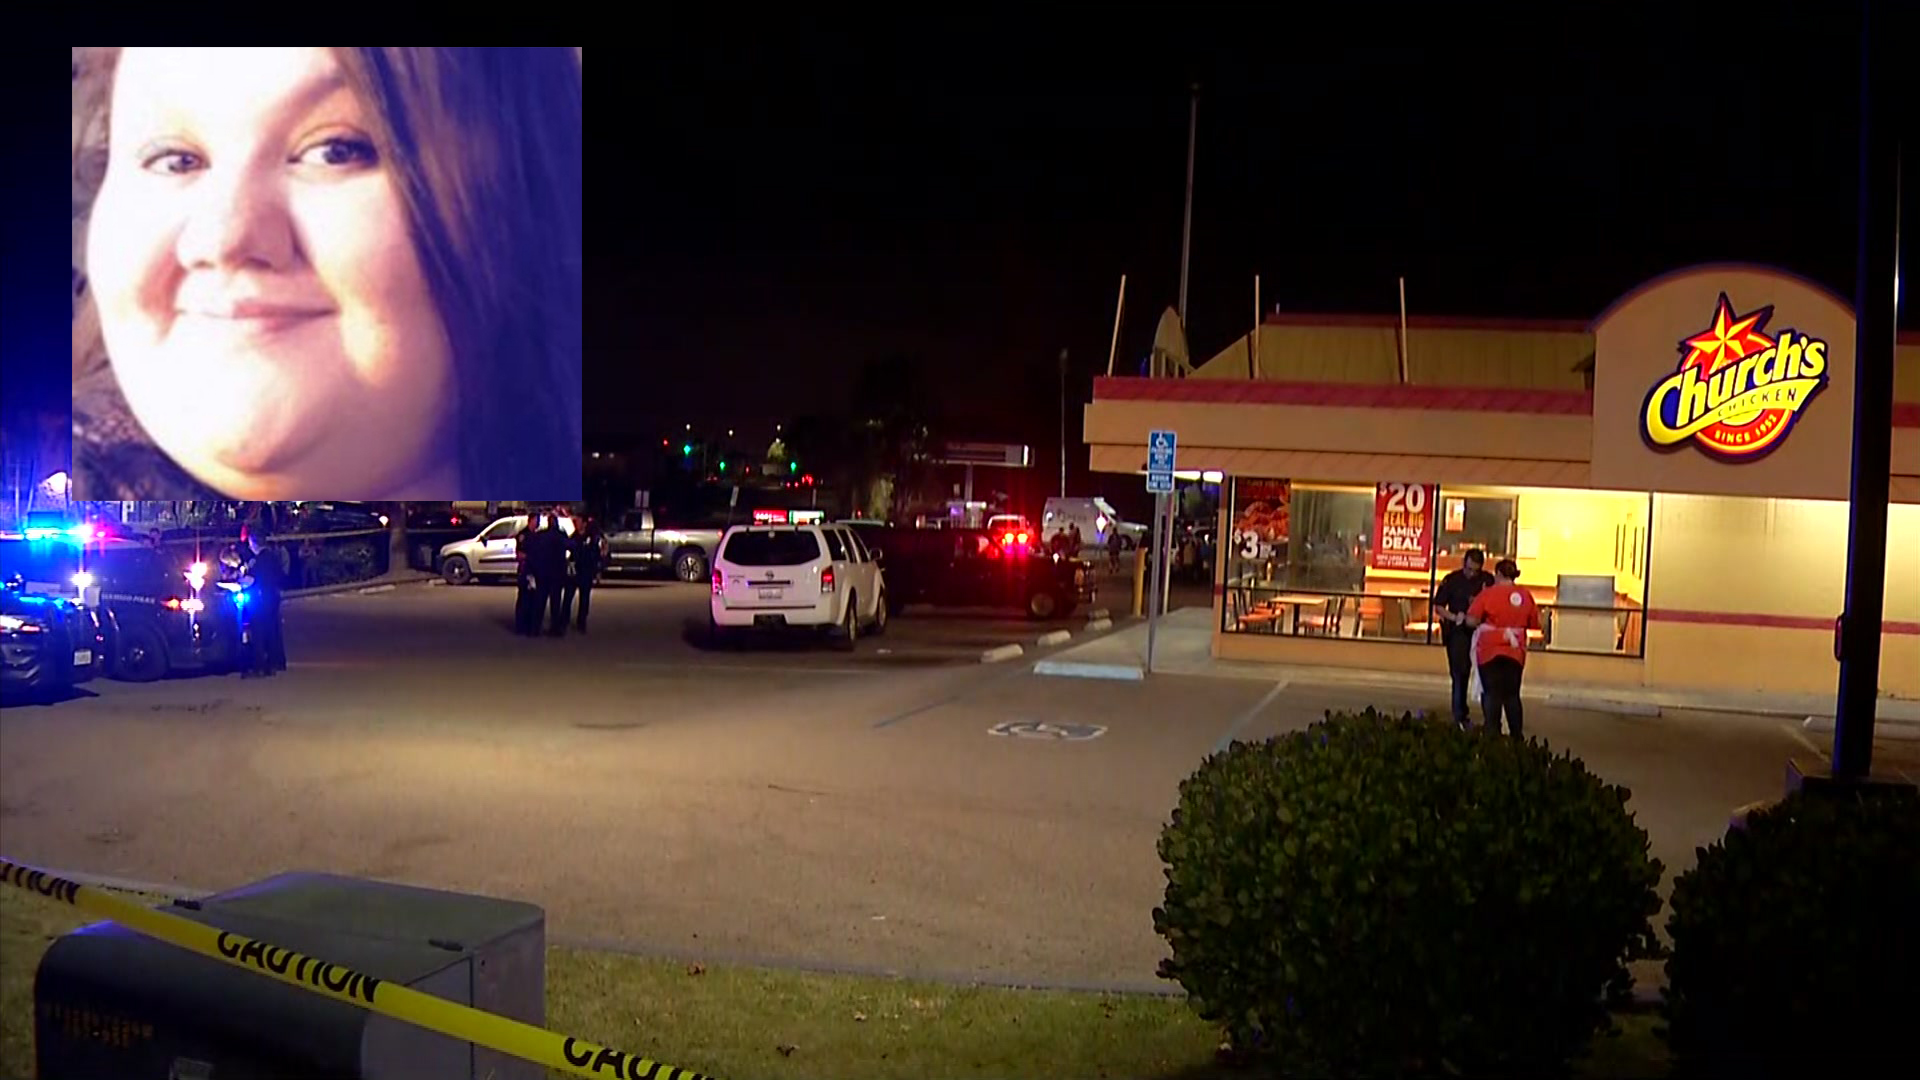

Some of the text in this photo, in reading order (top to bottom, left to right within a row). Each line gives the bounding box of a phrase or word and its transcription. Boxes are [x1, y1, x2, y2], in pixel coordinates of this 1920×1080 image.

[1647, 332, 1825, 444] Church's
[1718, 387, 1797, 417] CHICKEN
[1714, 413, 1777, 443] SINCE 1952
[1380, 482, 1425, 513] $20
[1382, 537, 1422, 550] DEAL
[1383, 526, 1422, 537] FAMILY
[218, 931, 380, 1003] CAUTION
